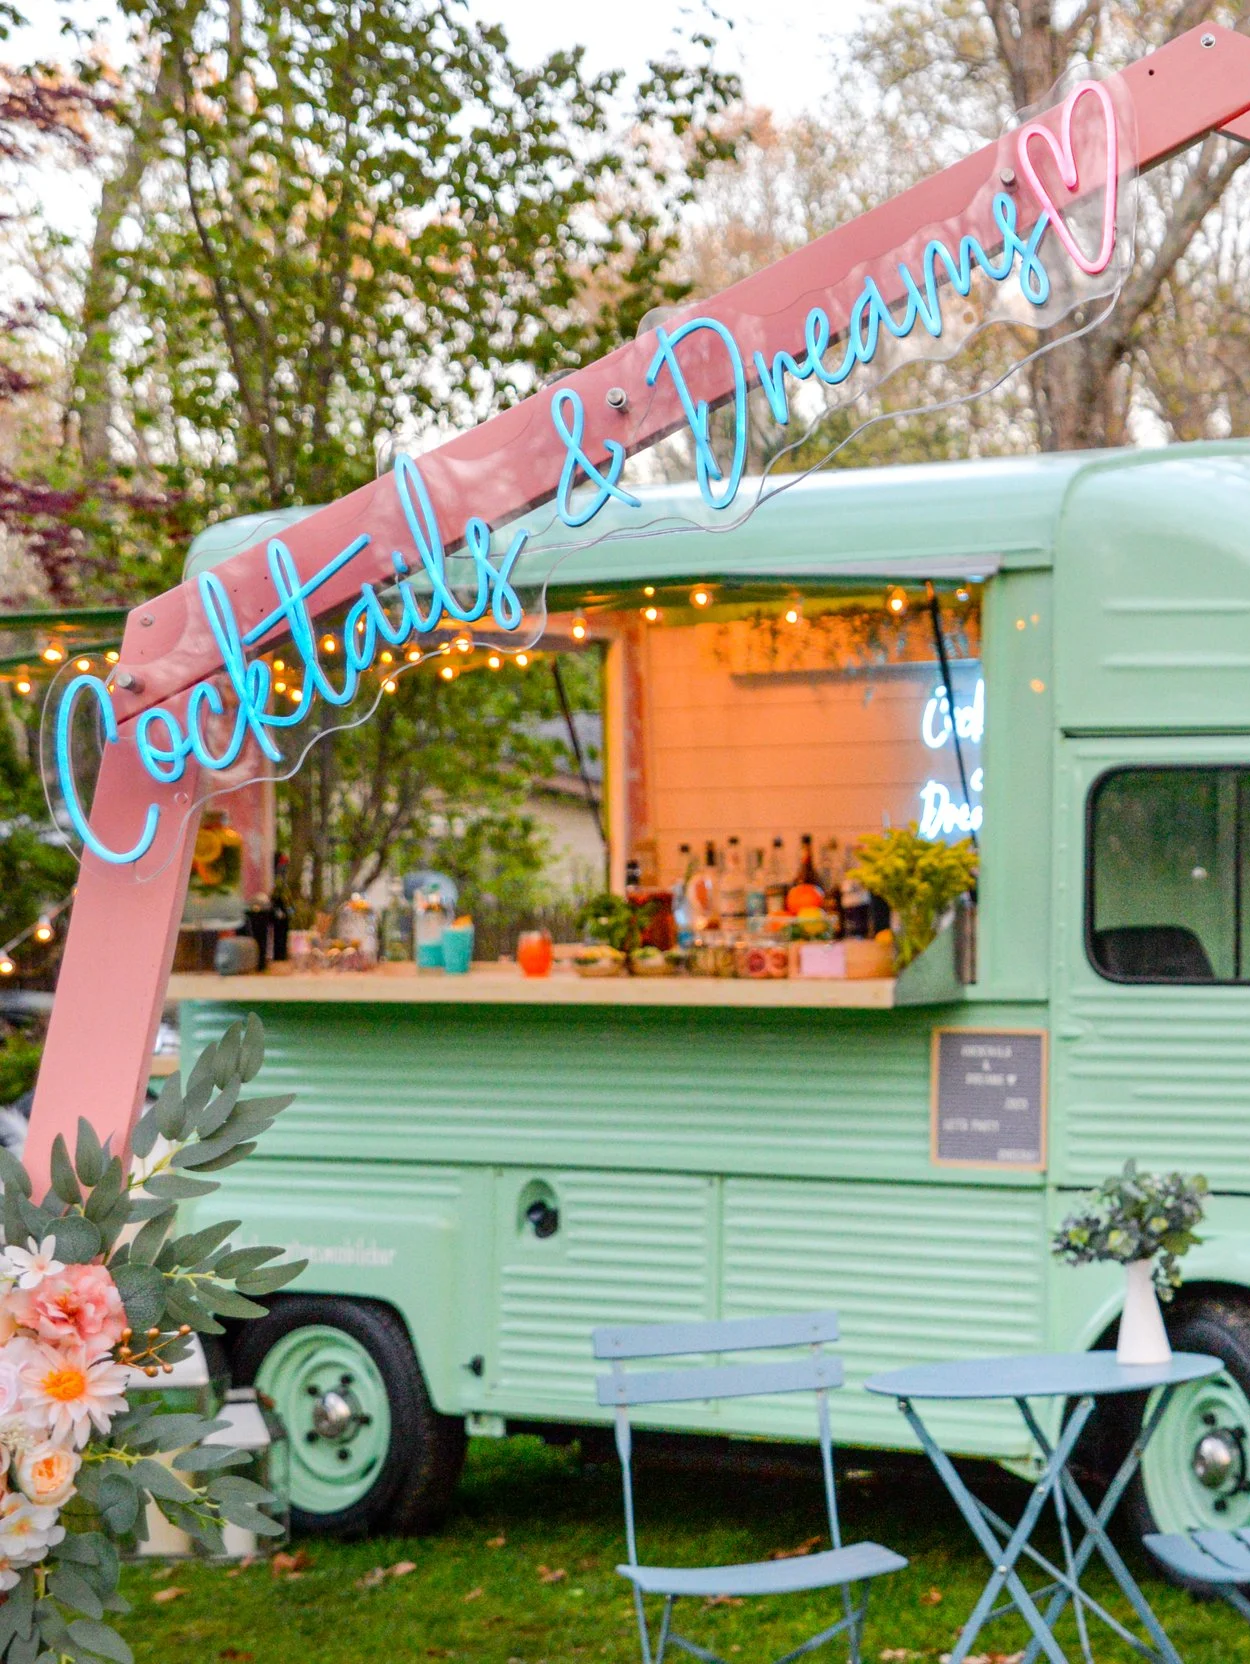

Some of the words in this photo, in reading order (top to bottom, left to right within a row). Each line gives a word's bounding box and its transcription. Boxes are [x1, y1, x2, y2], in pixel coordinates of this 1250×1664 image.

[56, 452, 531, 864] Cocktails
[551, 387, 642, 528] &
[645, 191, 1051, 510] Dreams
